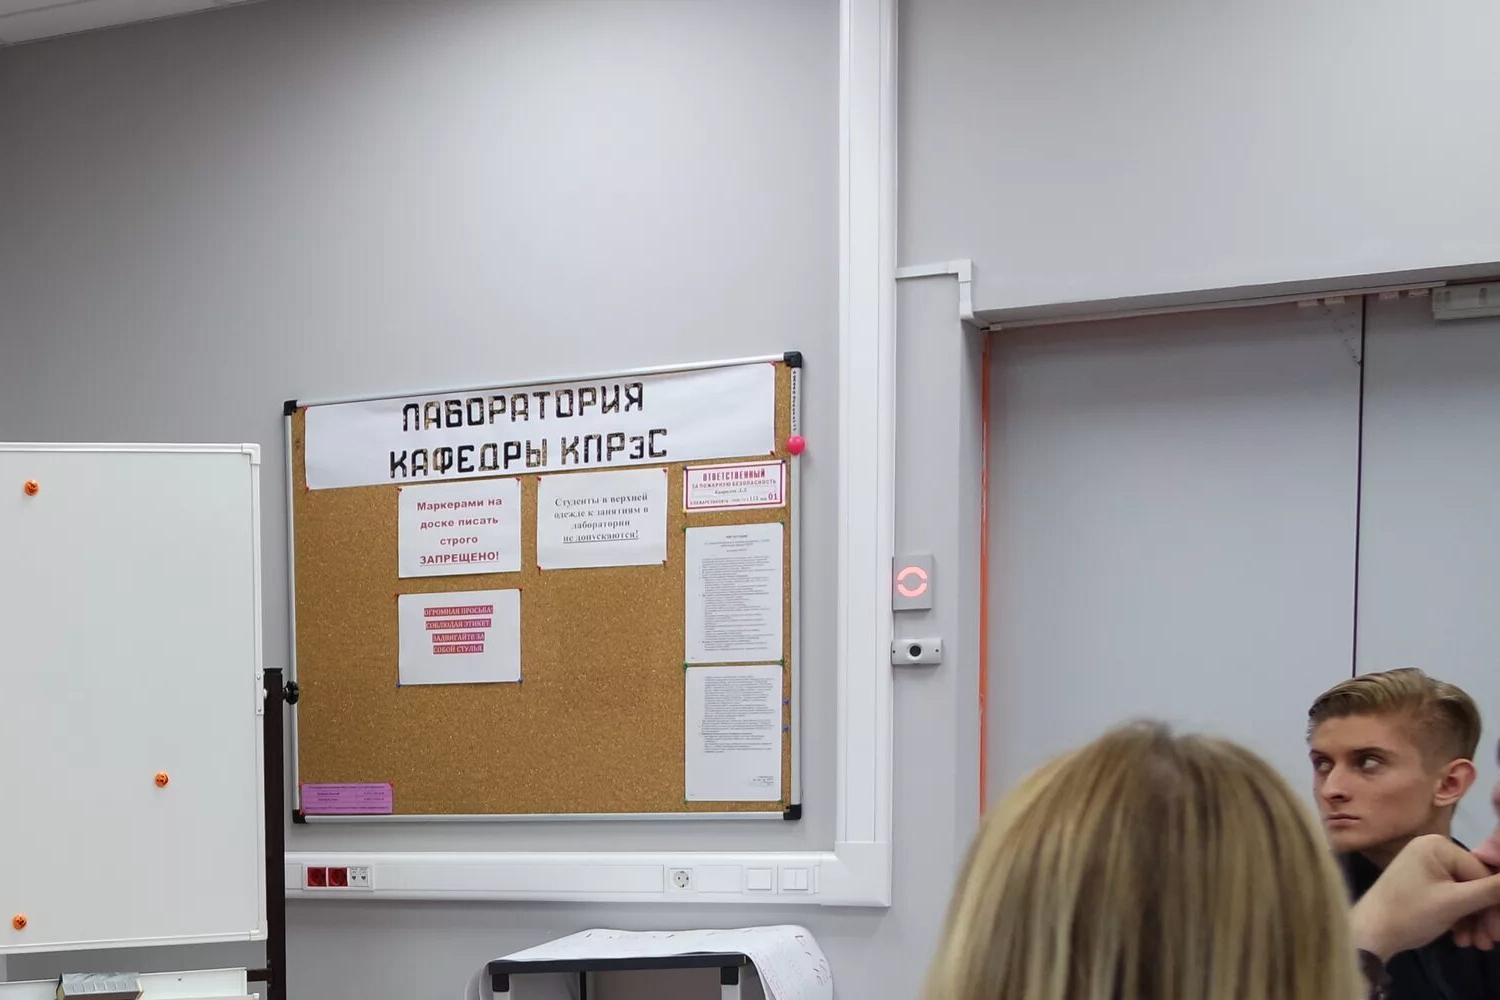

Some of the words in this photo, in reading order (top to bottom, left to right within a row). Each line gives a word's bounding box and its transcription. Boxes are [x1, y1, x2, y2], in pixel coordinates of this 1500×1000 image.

[401, 381, 644, 433] ЛАБОРАТОРИЯ
[389, 437, 548, 480] КАФЕДРЫ
[702, 468, 766, 482] ОТВЕТСТВЕННЫЙ
[700, 481, 731, 489] ПОЖАРНУЮ
[732, 478, 777, 487] БЕЗОПАСНОСТЬ
[554, 497, 600, 508] Студенты
[610, 492, 648, 504] верхней
[768, 492, 778, 500] 01
[417, 499, 484, 512] Маркерами
[487, 498, 503, 507] на
[554, 510, 586, 519] одежде
[597, 507, 641, 517] занятиям
[420, 519, 455, 530] доске
[458, 517, 499, 527] писать
[571, 518, 630, 532] лаборатории
[440, 536, 478, 547] строго
[563, 535, 574, 543] не
[575, 529, 639, 543] допускаются!
[420, 551, 499, 565] ЗАПРЕЩЕНО!
[424, 606, 460, 616] ОГРОМНАЯ
[426, 620, 463, 629] СОБЛЮДАЯ
[433, 633, 476, 642] ЗАДВИГАЙТЕ
[433, 644, 456, 654] СОБОЙ
